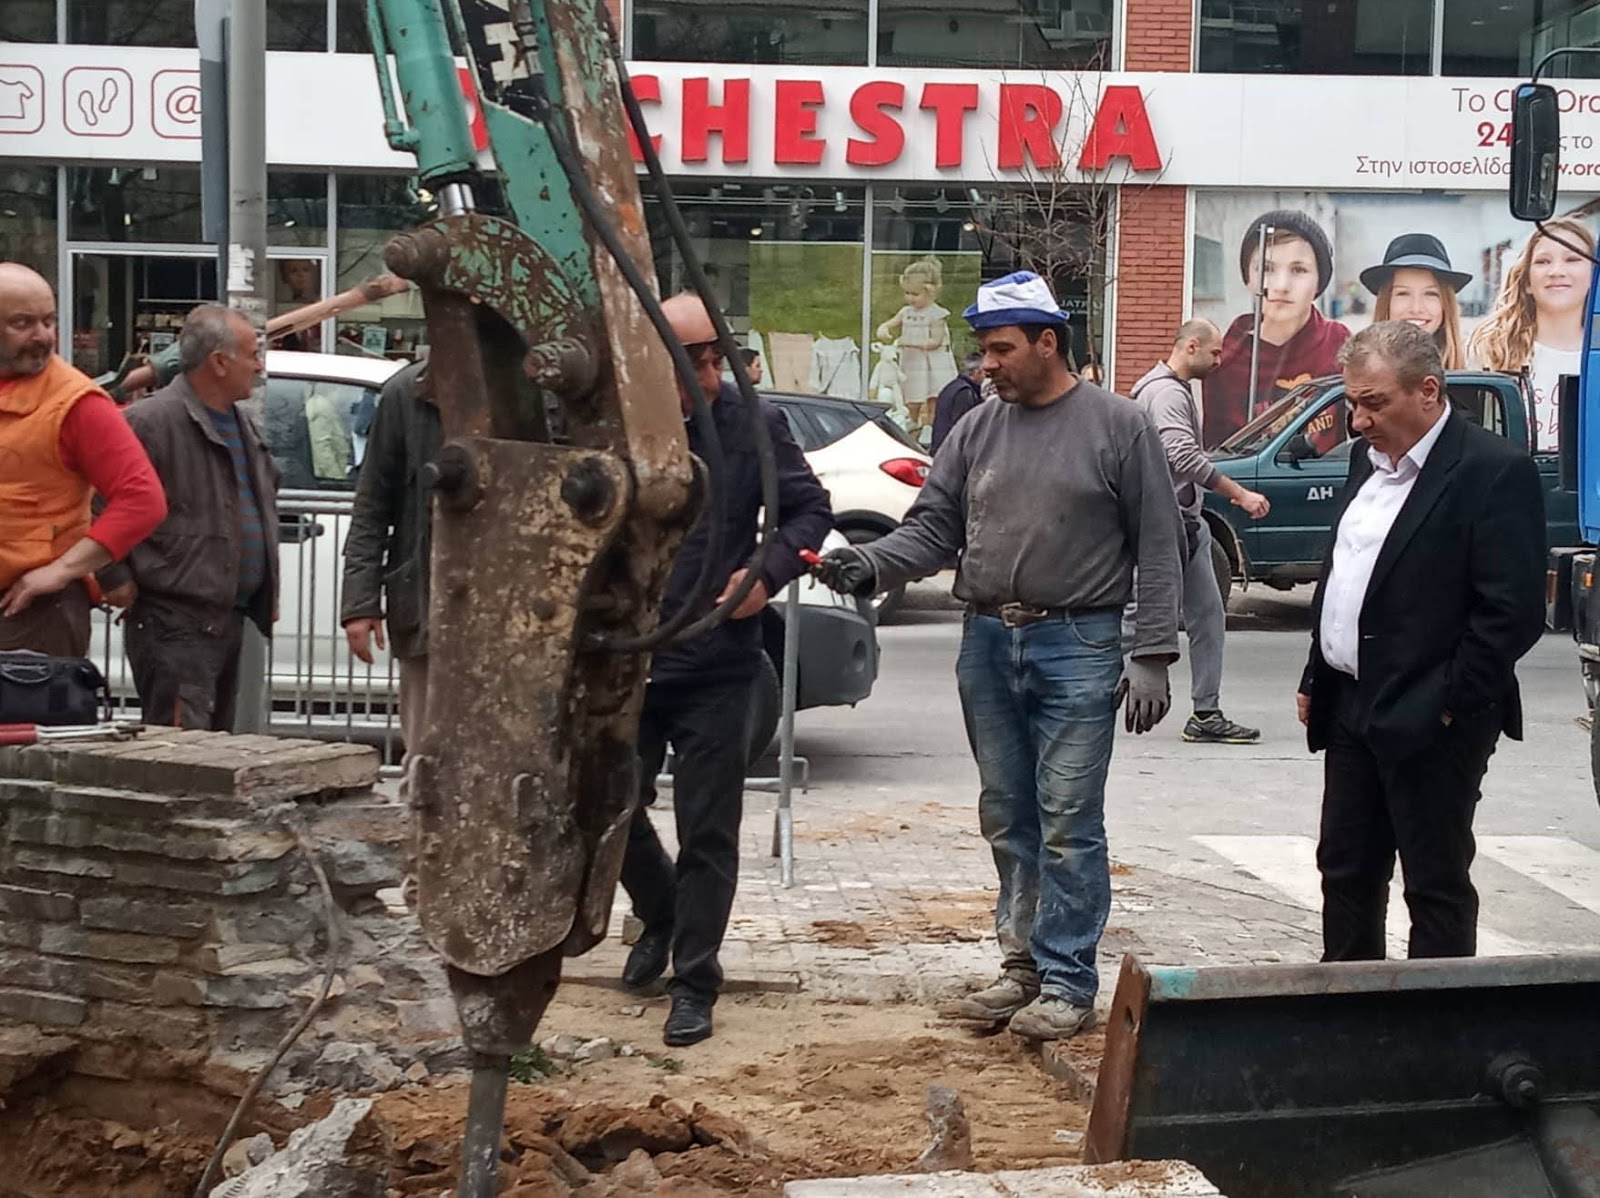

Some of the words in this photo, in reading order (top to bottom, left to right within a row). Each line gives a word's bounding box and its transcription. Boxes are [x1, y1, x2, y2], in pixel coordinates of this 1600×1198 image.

[456, 68, 1163, 172] CHESTRA
[1477, 121, 1514, 147] 24
[1356, 156, 1403, 178] Στην
